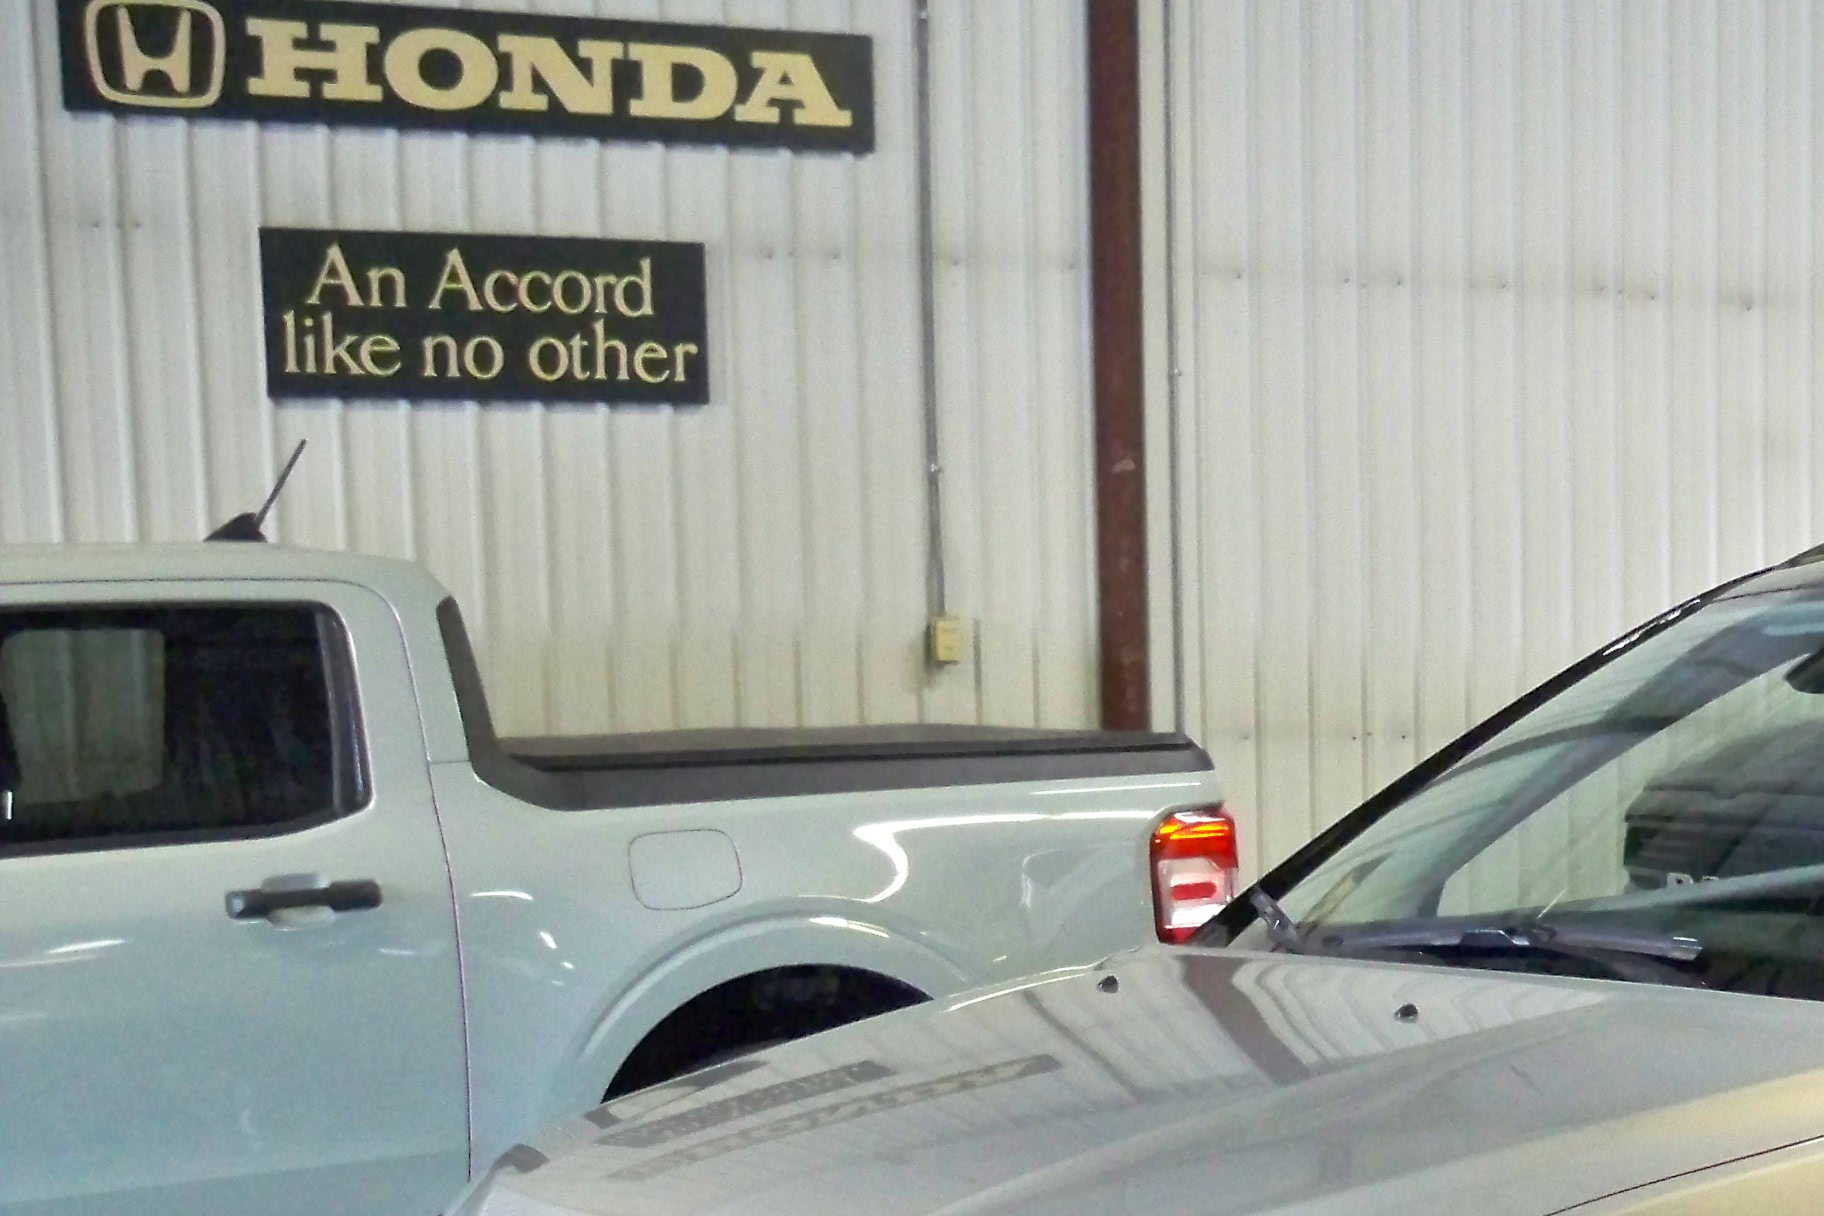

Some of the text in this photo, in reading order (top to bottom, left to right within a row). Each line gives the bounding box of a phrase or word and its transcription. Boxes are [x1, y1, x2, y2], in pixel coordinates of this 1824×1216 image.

[246, 17, 852, 128] HONDA
[308, 243, 655, 316] An Accord
[282, 311, 698, 384] like no other
